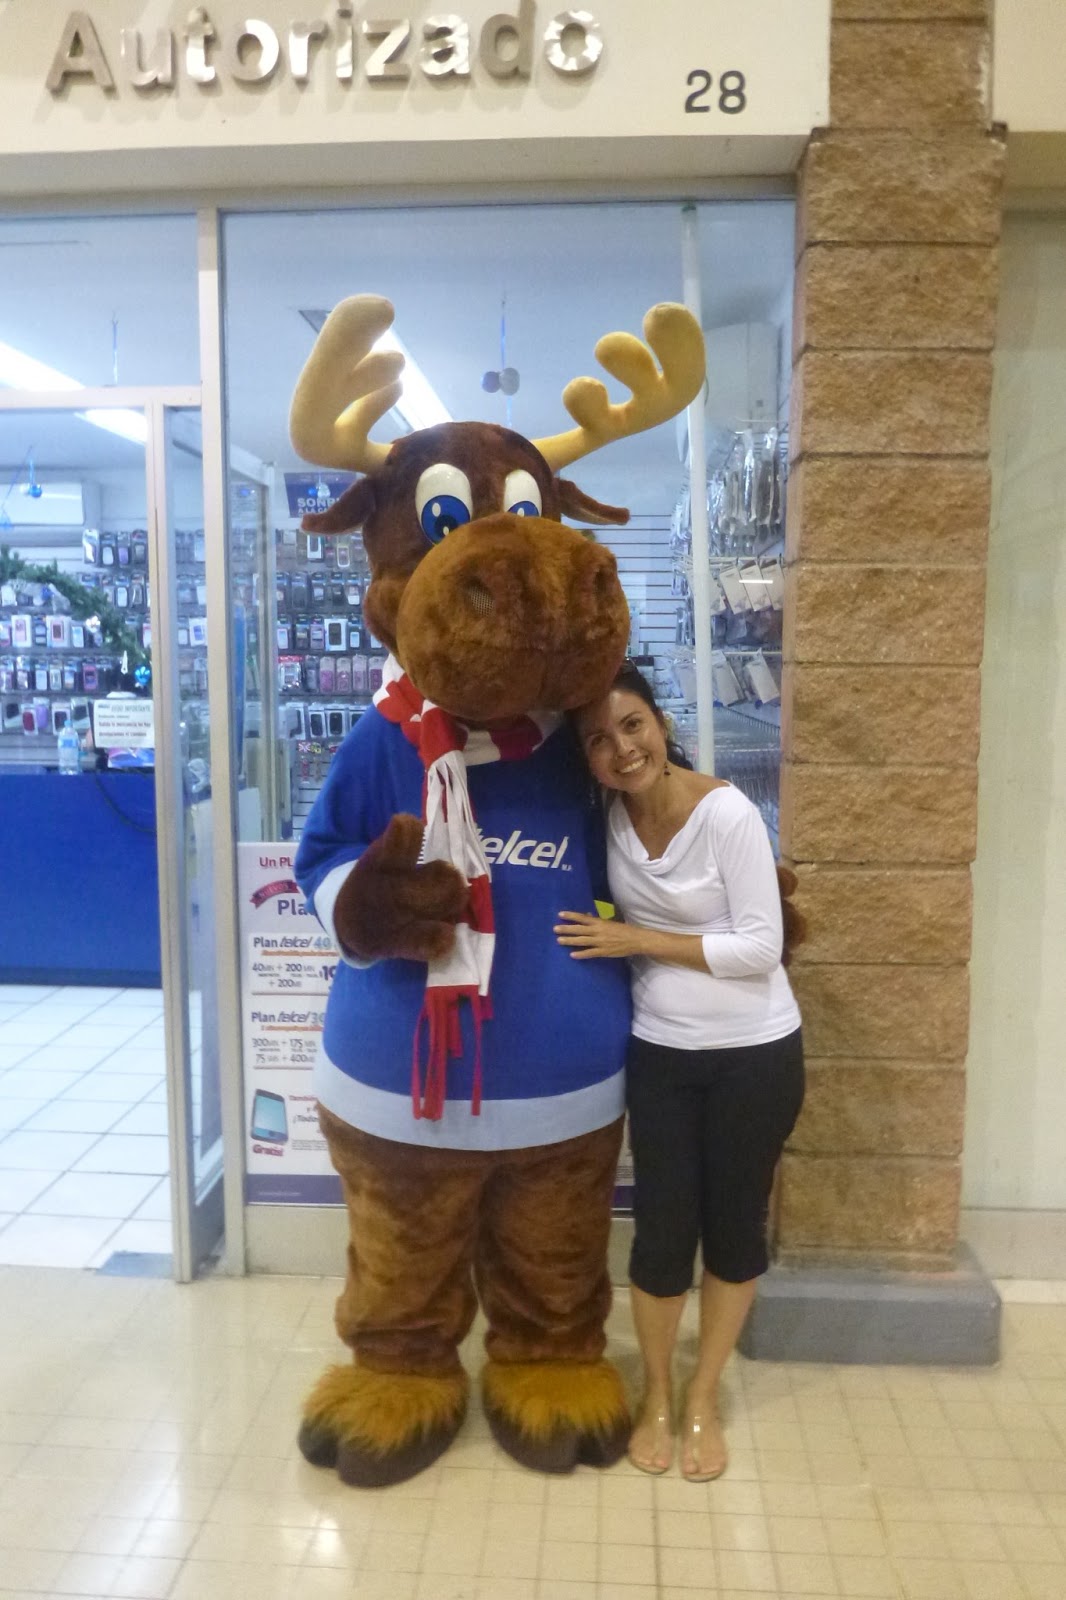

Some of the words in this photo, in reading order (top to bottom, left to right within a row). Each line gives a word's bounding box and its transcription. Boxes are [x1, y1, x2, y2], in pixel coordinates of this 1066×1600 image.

[46, 0, 602, 95] Autorizado
[684, 69, 747, 114] 28
[259, 857, 277, 868] Un
[253, 936, 278, 948] Plan
[252, 1011, 275, 1022] Plan
